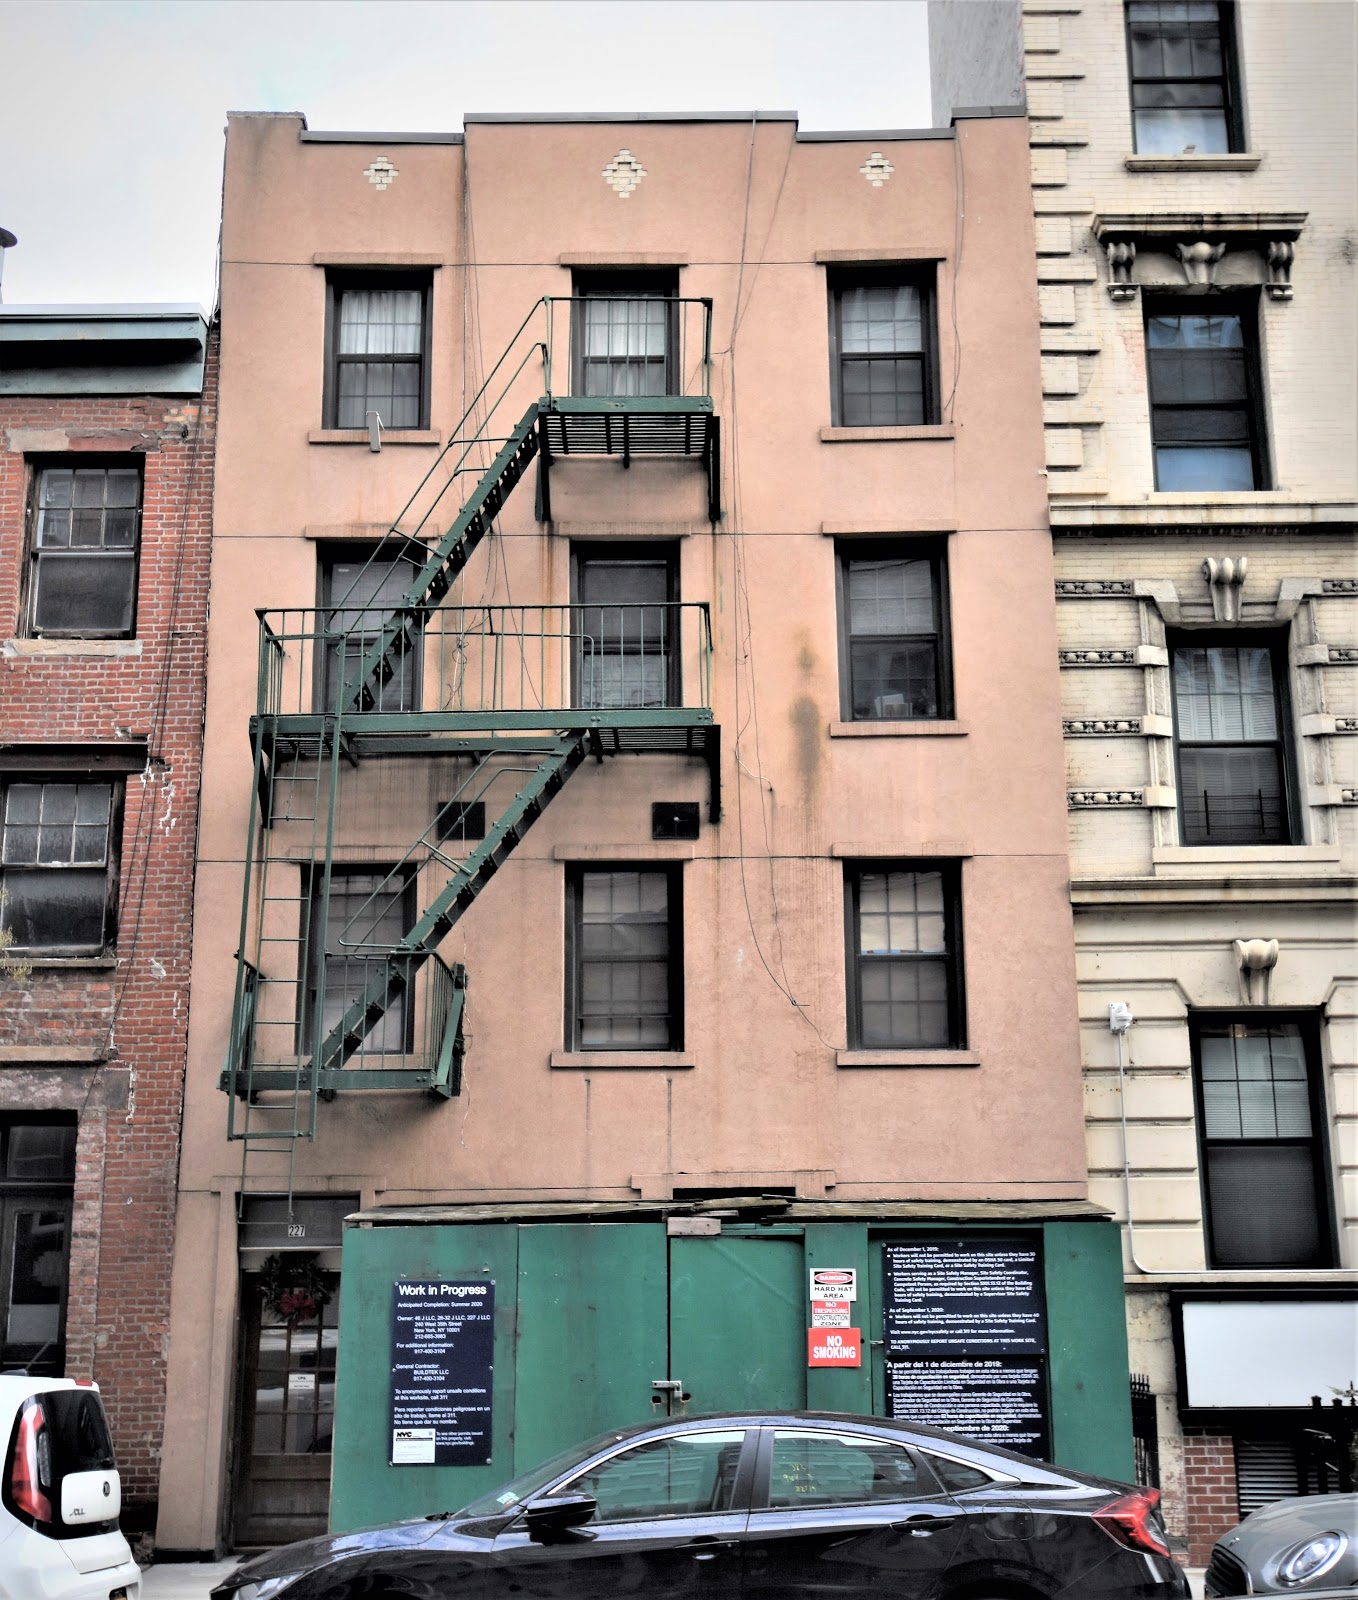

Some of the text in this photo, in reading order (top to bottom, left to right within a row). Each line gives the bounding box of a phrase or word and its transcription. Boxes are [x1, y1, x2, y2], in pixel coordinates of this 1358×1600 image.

[289, 1226, 304, 1236] 227
[399, 1285, 487, 1297] Work in Progress
[827, 1336, 842, 1346] NO
[813, 1346, 856, 1358] SMOKING
